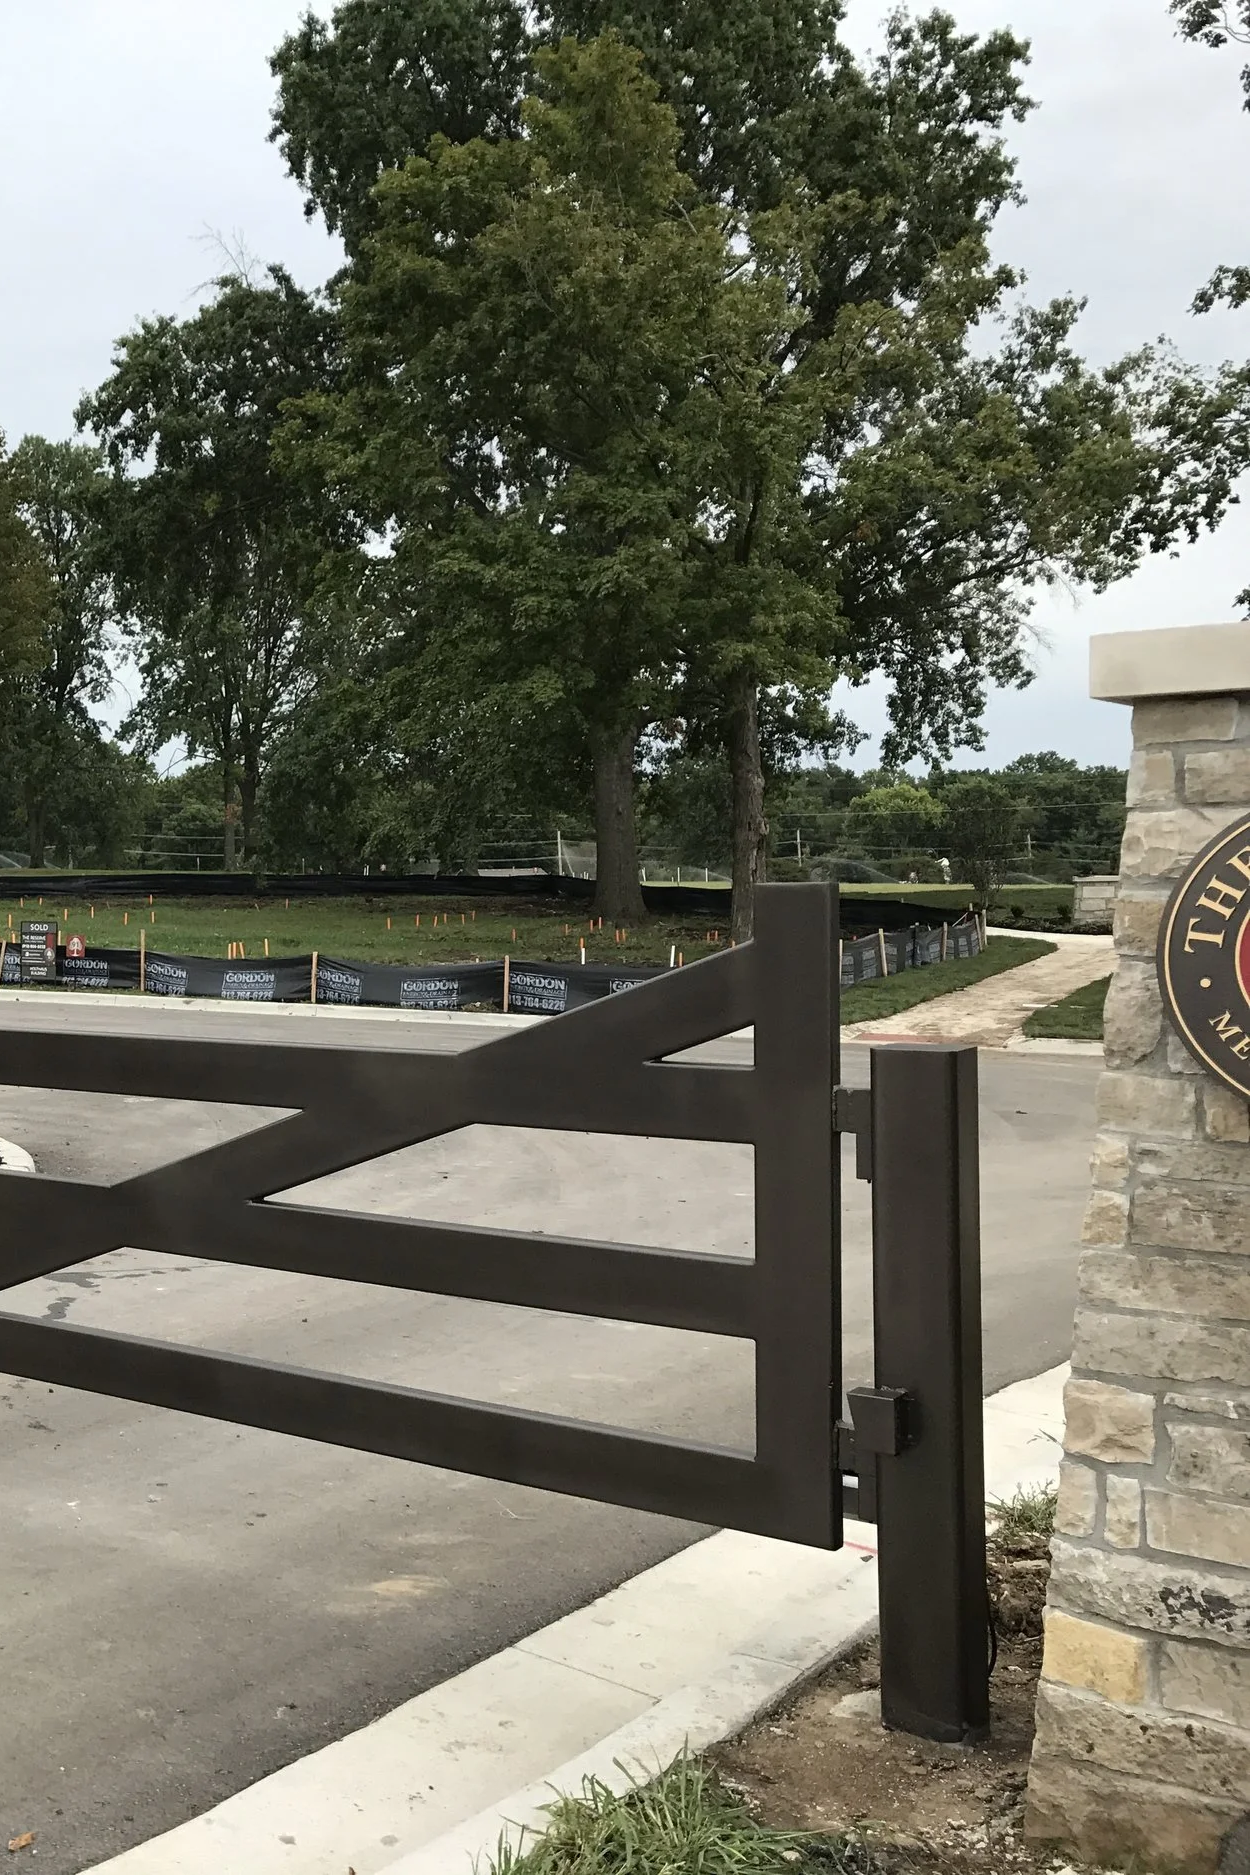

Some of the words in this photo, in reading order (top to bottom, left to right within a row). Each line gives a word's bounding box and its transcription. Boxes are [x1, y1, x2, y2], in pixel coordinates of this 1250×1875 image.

[30, 923, 49, 931] SOLD
[64, 959, 109, 970] GORDON
[225, 972, 275, 983] GORDON
[316, 969, 361, 986] ORDON
[509, 972, 566, 990] GORDON
[403, 979, 459, 992] GORDON
